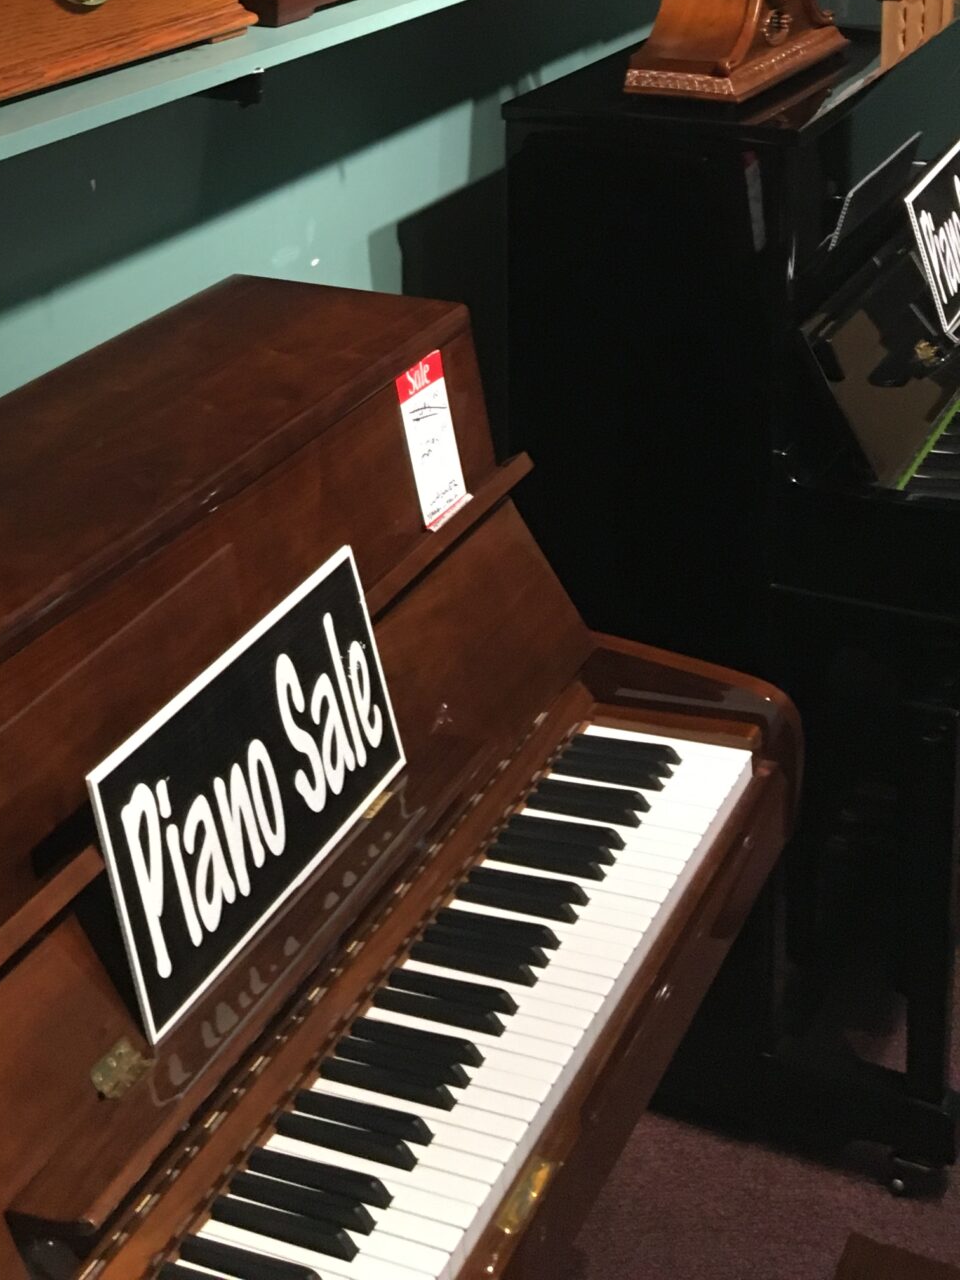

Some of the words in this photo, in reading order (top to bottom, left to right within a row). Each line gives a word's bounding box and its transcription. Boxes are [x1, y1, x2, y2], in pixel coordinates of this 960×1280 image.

[405, 361, 431, 396] Sale
[120, 737, 287, 980] Piano
[275, 611, 383, 814] Sale
